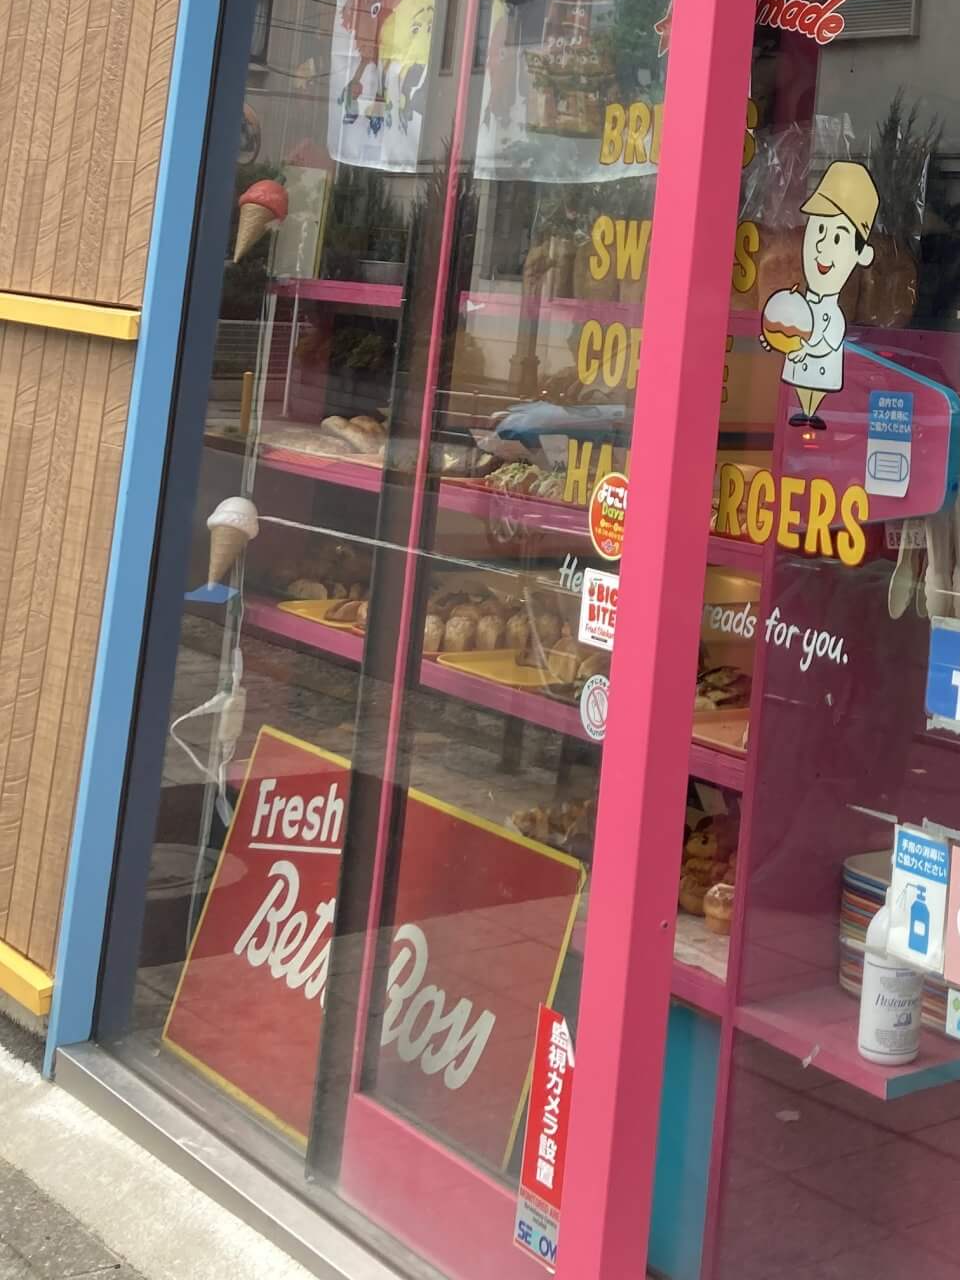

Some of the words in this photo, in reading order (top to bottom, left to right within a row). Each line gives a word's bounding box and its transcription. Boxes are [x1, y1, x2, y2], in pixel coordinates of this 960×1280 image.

[588, 603, 616, 628] BITE
[597, 582, 618, 608] BIG
[765, 606, 800, 649] for
[799, 627, 849, 672] you.
[250, 778, 345, 844] Fresh
[897, 852, 946, 877] ご協力ください
[902, 838, 945, 863] 手指の消毒に
[234, 860, 336, 1008] Bets
[380, 923, 497, 1089] Ross
